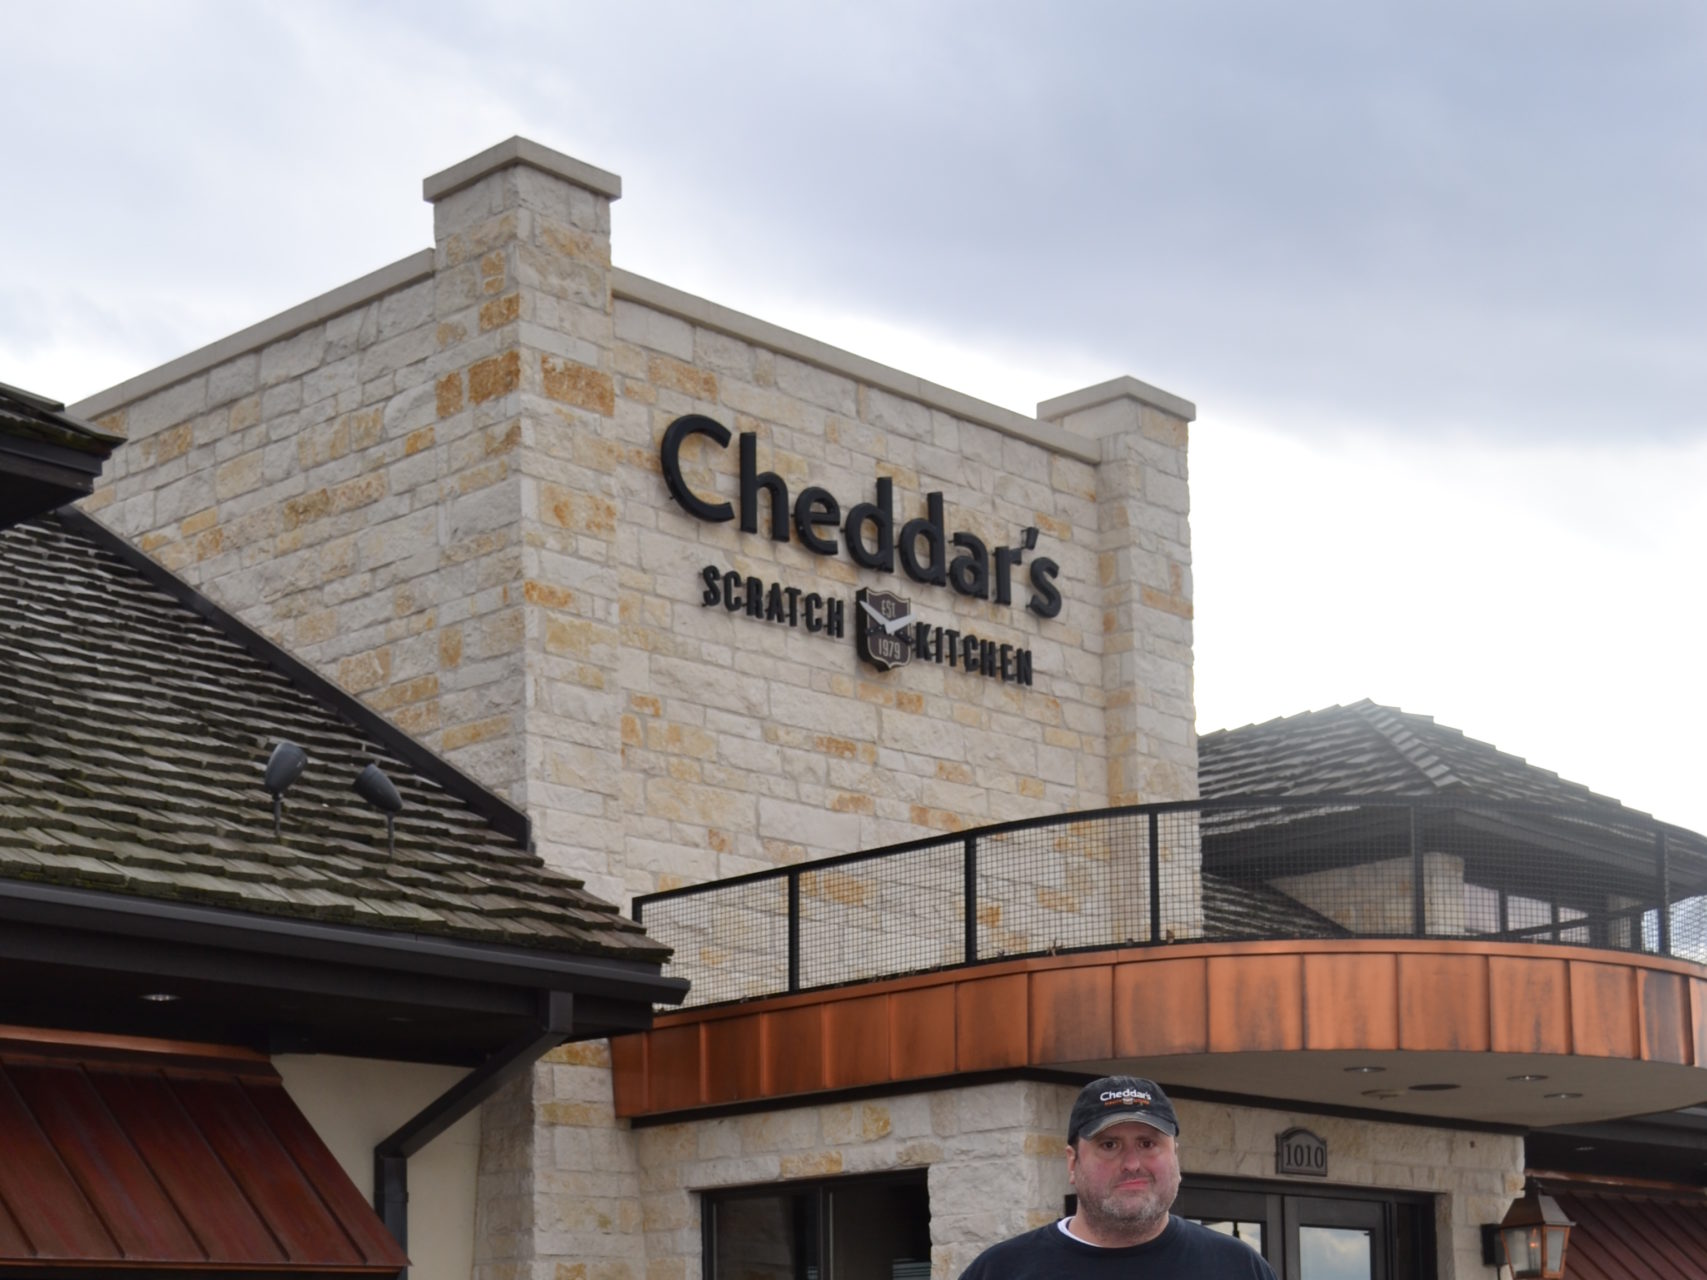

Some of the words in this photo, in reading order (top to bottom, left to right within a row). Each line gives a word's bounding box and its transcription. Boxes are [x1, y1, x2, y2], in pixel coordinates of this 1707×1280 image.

[661, 413, 1062, 618] Cheddar's
[702, 565, 844, 638] SCRATCH
[915, 621, 1033, 686] KITCHEN
[878, 638, 901, 660] 1979
[1285, 1143, 1325, 1169] 1010
